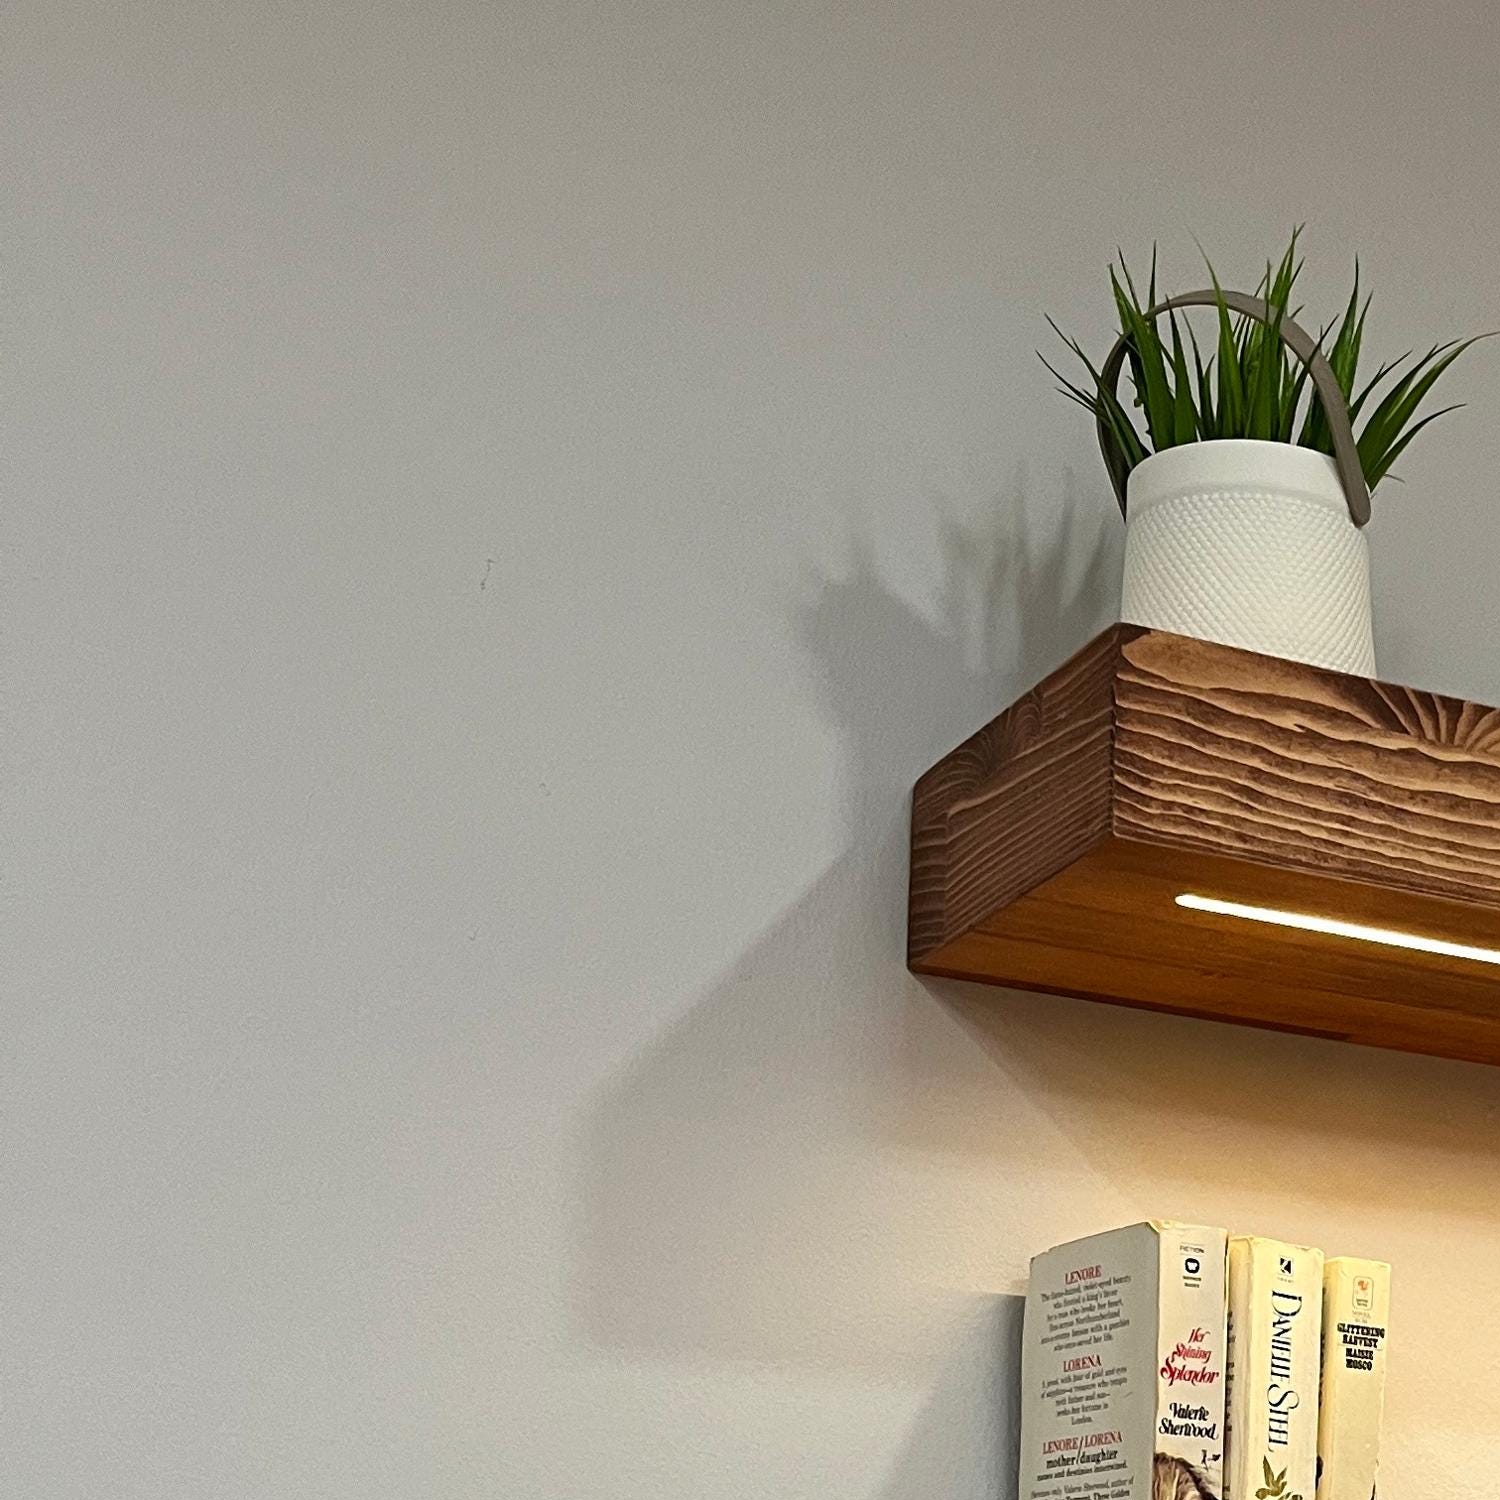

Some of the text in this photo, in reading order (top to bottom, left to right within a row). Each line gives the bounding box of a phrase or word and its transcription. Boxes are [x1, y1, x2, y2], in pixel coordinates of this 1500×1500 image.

[1064, 1265, 1102, 1285] LENORE
[1188, 1327, 1210, 1343] Her
[1270, 1290, 1303, 1384] DANIELLE
[1337, 1322, 1385, 1339] GLITTERING
[1342, 1334, 1378, 1348] HARVEST
[1171, 1342, 1212, 1364] Shining
[1346, 1348, 1374, 1360] MAISIE
[1064, 1355, 1101, 1373] LORENA
[1159, 1356, 1219, 1387] Splendor
[1345, 1358, 1373, 1371] MOSCO
[1169, 1402, 1209, 1421] Valerie
[1267, 1383, 1300, 1453] STEEL
[1158, 1417, 1219, 1440] Sherwood
